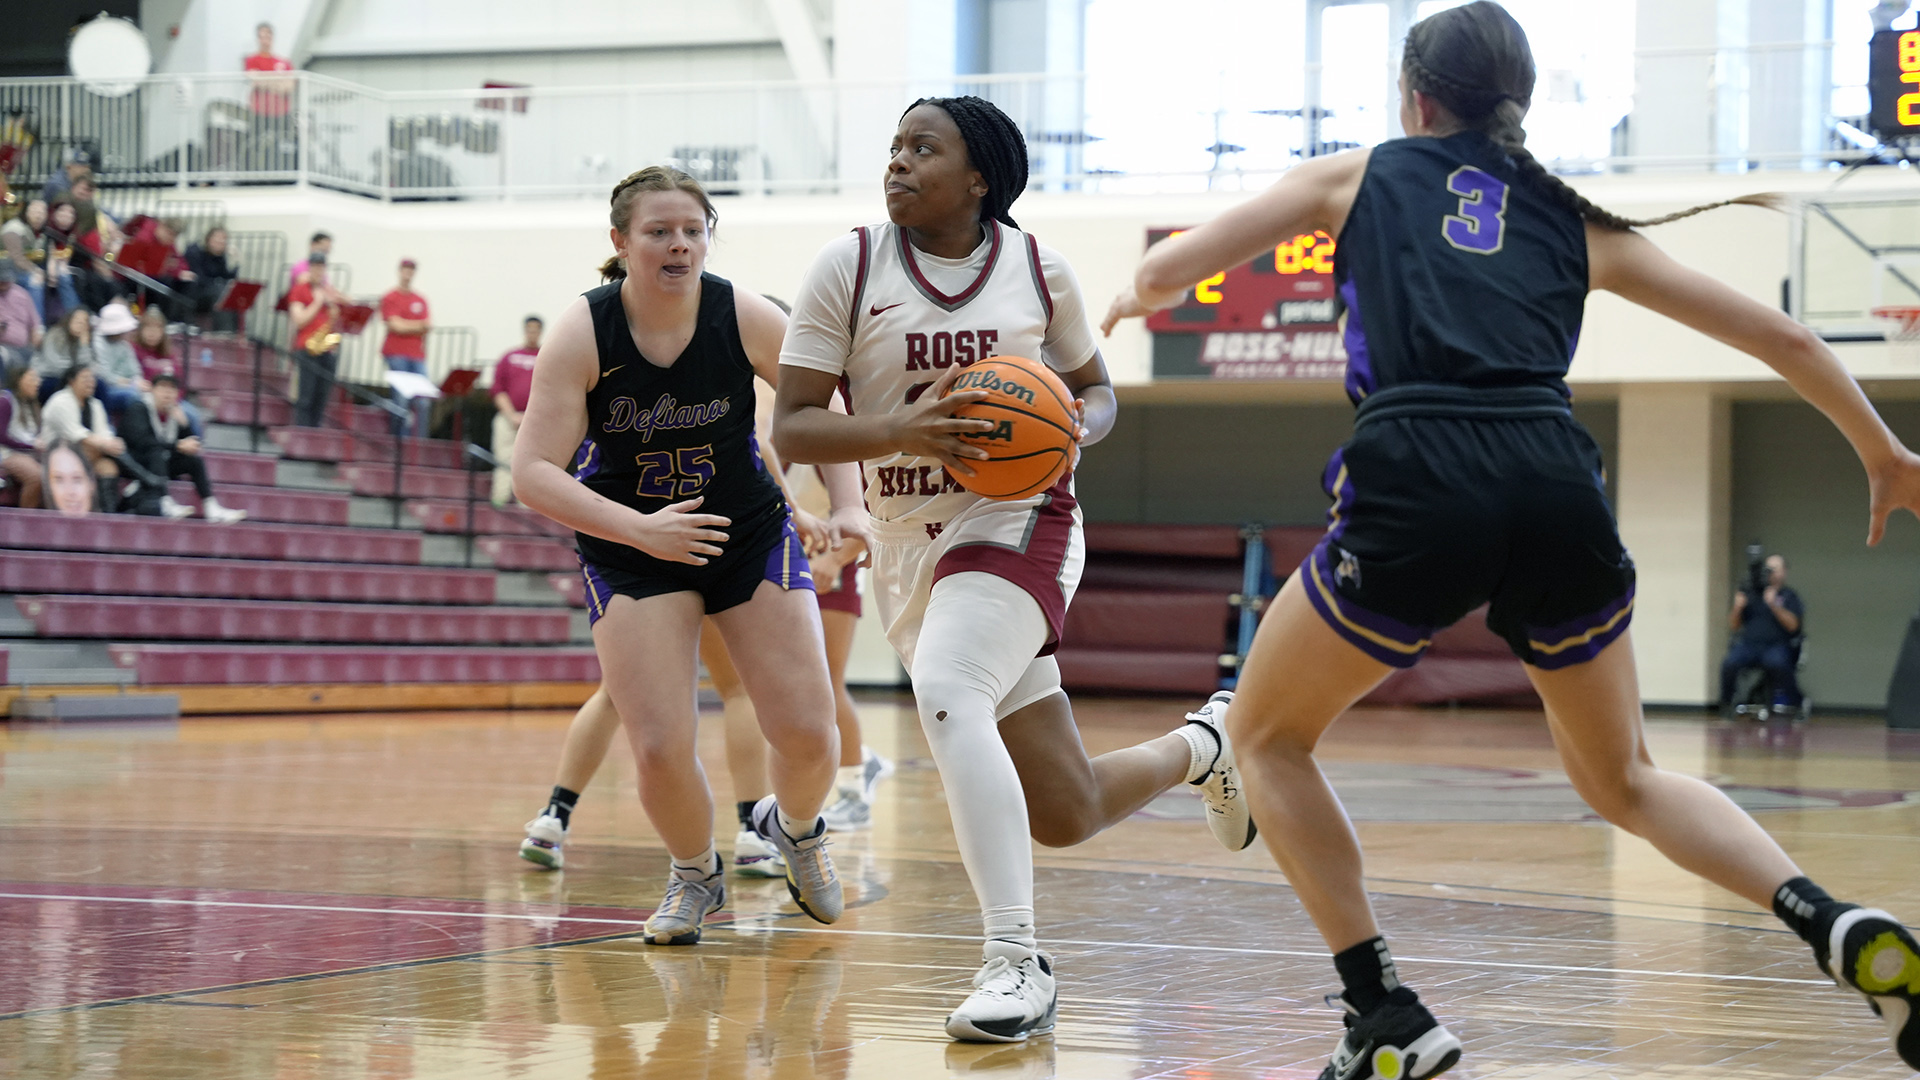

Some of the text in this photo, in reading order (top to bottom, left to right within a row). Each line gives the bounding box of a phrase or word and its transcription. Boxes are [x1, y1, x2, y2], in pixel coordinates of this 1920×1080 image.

[1441, 165, 1510, 255] 3
[905, 329, 998, 371] ROSE
[951, 370, 1036, 406] Wilson
[635, 443, 716, 500] 25
